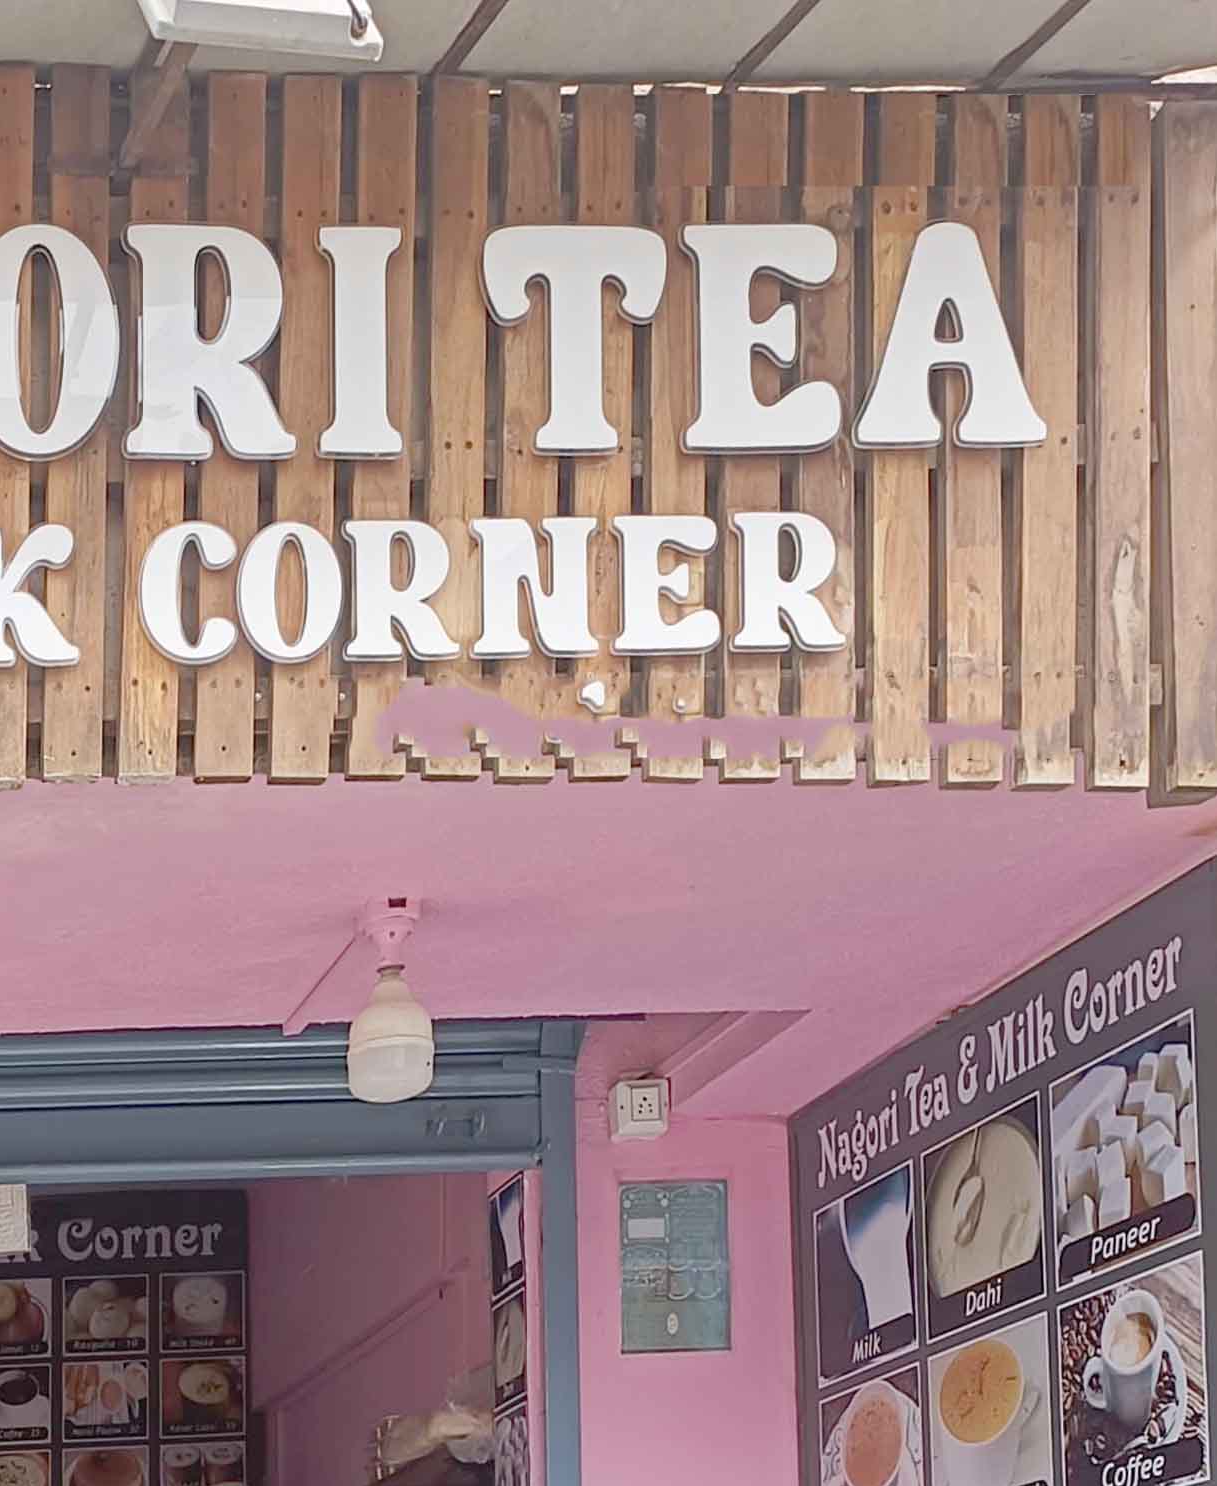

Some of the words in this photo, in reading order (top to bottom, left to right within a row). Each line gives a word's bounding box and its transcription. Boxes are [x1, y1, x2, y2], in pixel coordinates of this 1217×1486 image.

[481, 219, 1047, 457] TEA
[139, 510, 847, 664] CORNER
[817, 1087, 898, 1188] Nagori
[904, 1064, 951, 1136] Tea
[957, 1034, 979, 1104] &
[986, 993, 1058, 1093] Milk
[1063, 936, 1182, 1044] Corner
[56, 1217, 223, 1262] Corner
[1090, 1215, 1161, 1264] Paneer
[965, 1279, 1002, 1316] Dahi
[852, 1334, 882, 1363] Milk
